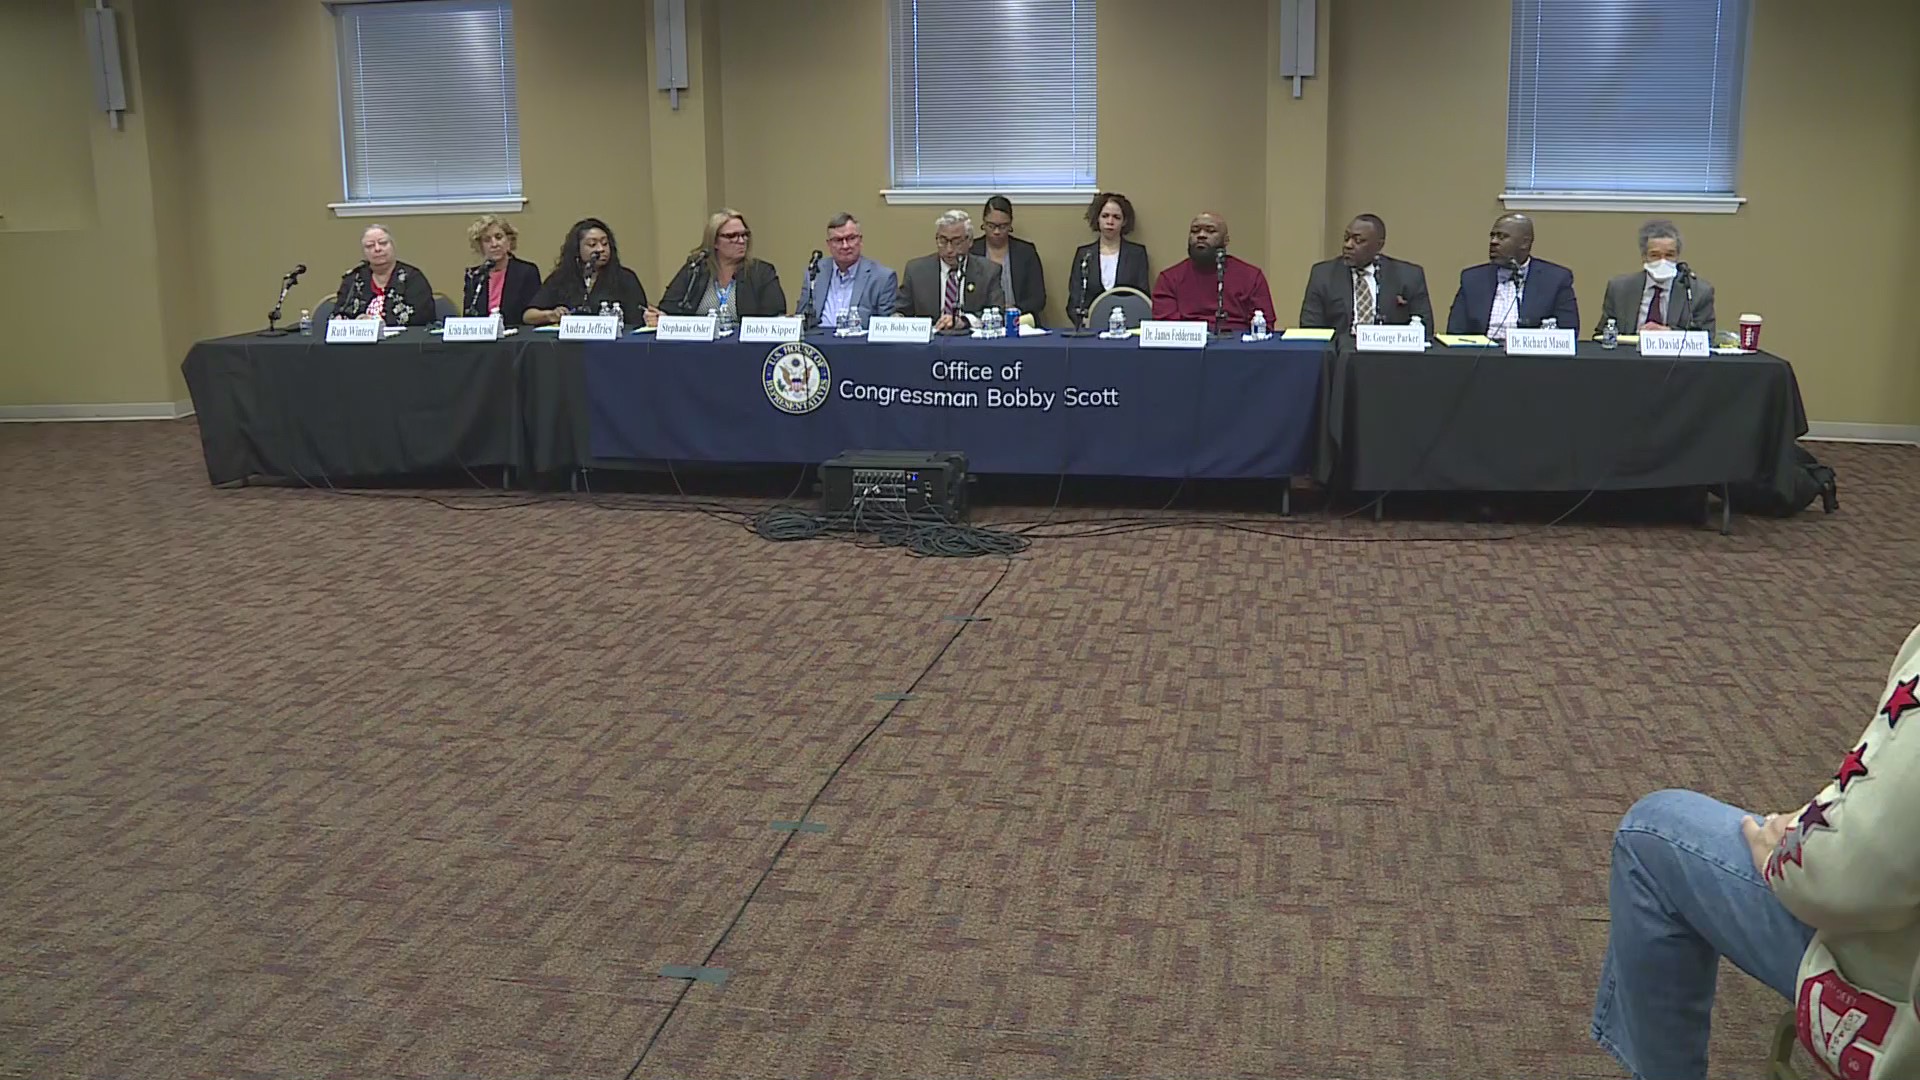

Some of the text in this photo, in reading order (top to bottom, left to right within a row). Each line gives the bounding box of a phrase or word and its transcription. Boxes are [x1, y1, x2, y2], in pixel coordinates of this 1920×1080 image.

[331, 325, 374, 337] Ruth Winters
[563, 322, 612, 335] Audra Jeffries
[661, 322, 691, 335] Stephanie
[746, 323, 796, 337] Bobby Kipper
[875, 322, 927, 335] Rep. Bobby Scott
[1145, 327, 1154, 341] Dr.
[1155, 328, 1171, 341] James
[1362, 332, 1419, 344] Dr. George Parker
[1511, 335, 1570, 349] Dr. Richard Mason
[1646, 338, 1703, 350] Dr. David Osher
[932, 361, 1023, 381] Office of
[839, 381, 1119, 411] Congressman Bobby Scott
